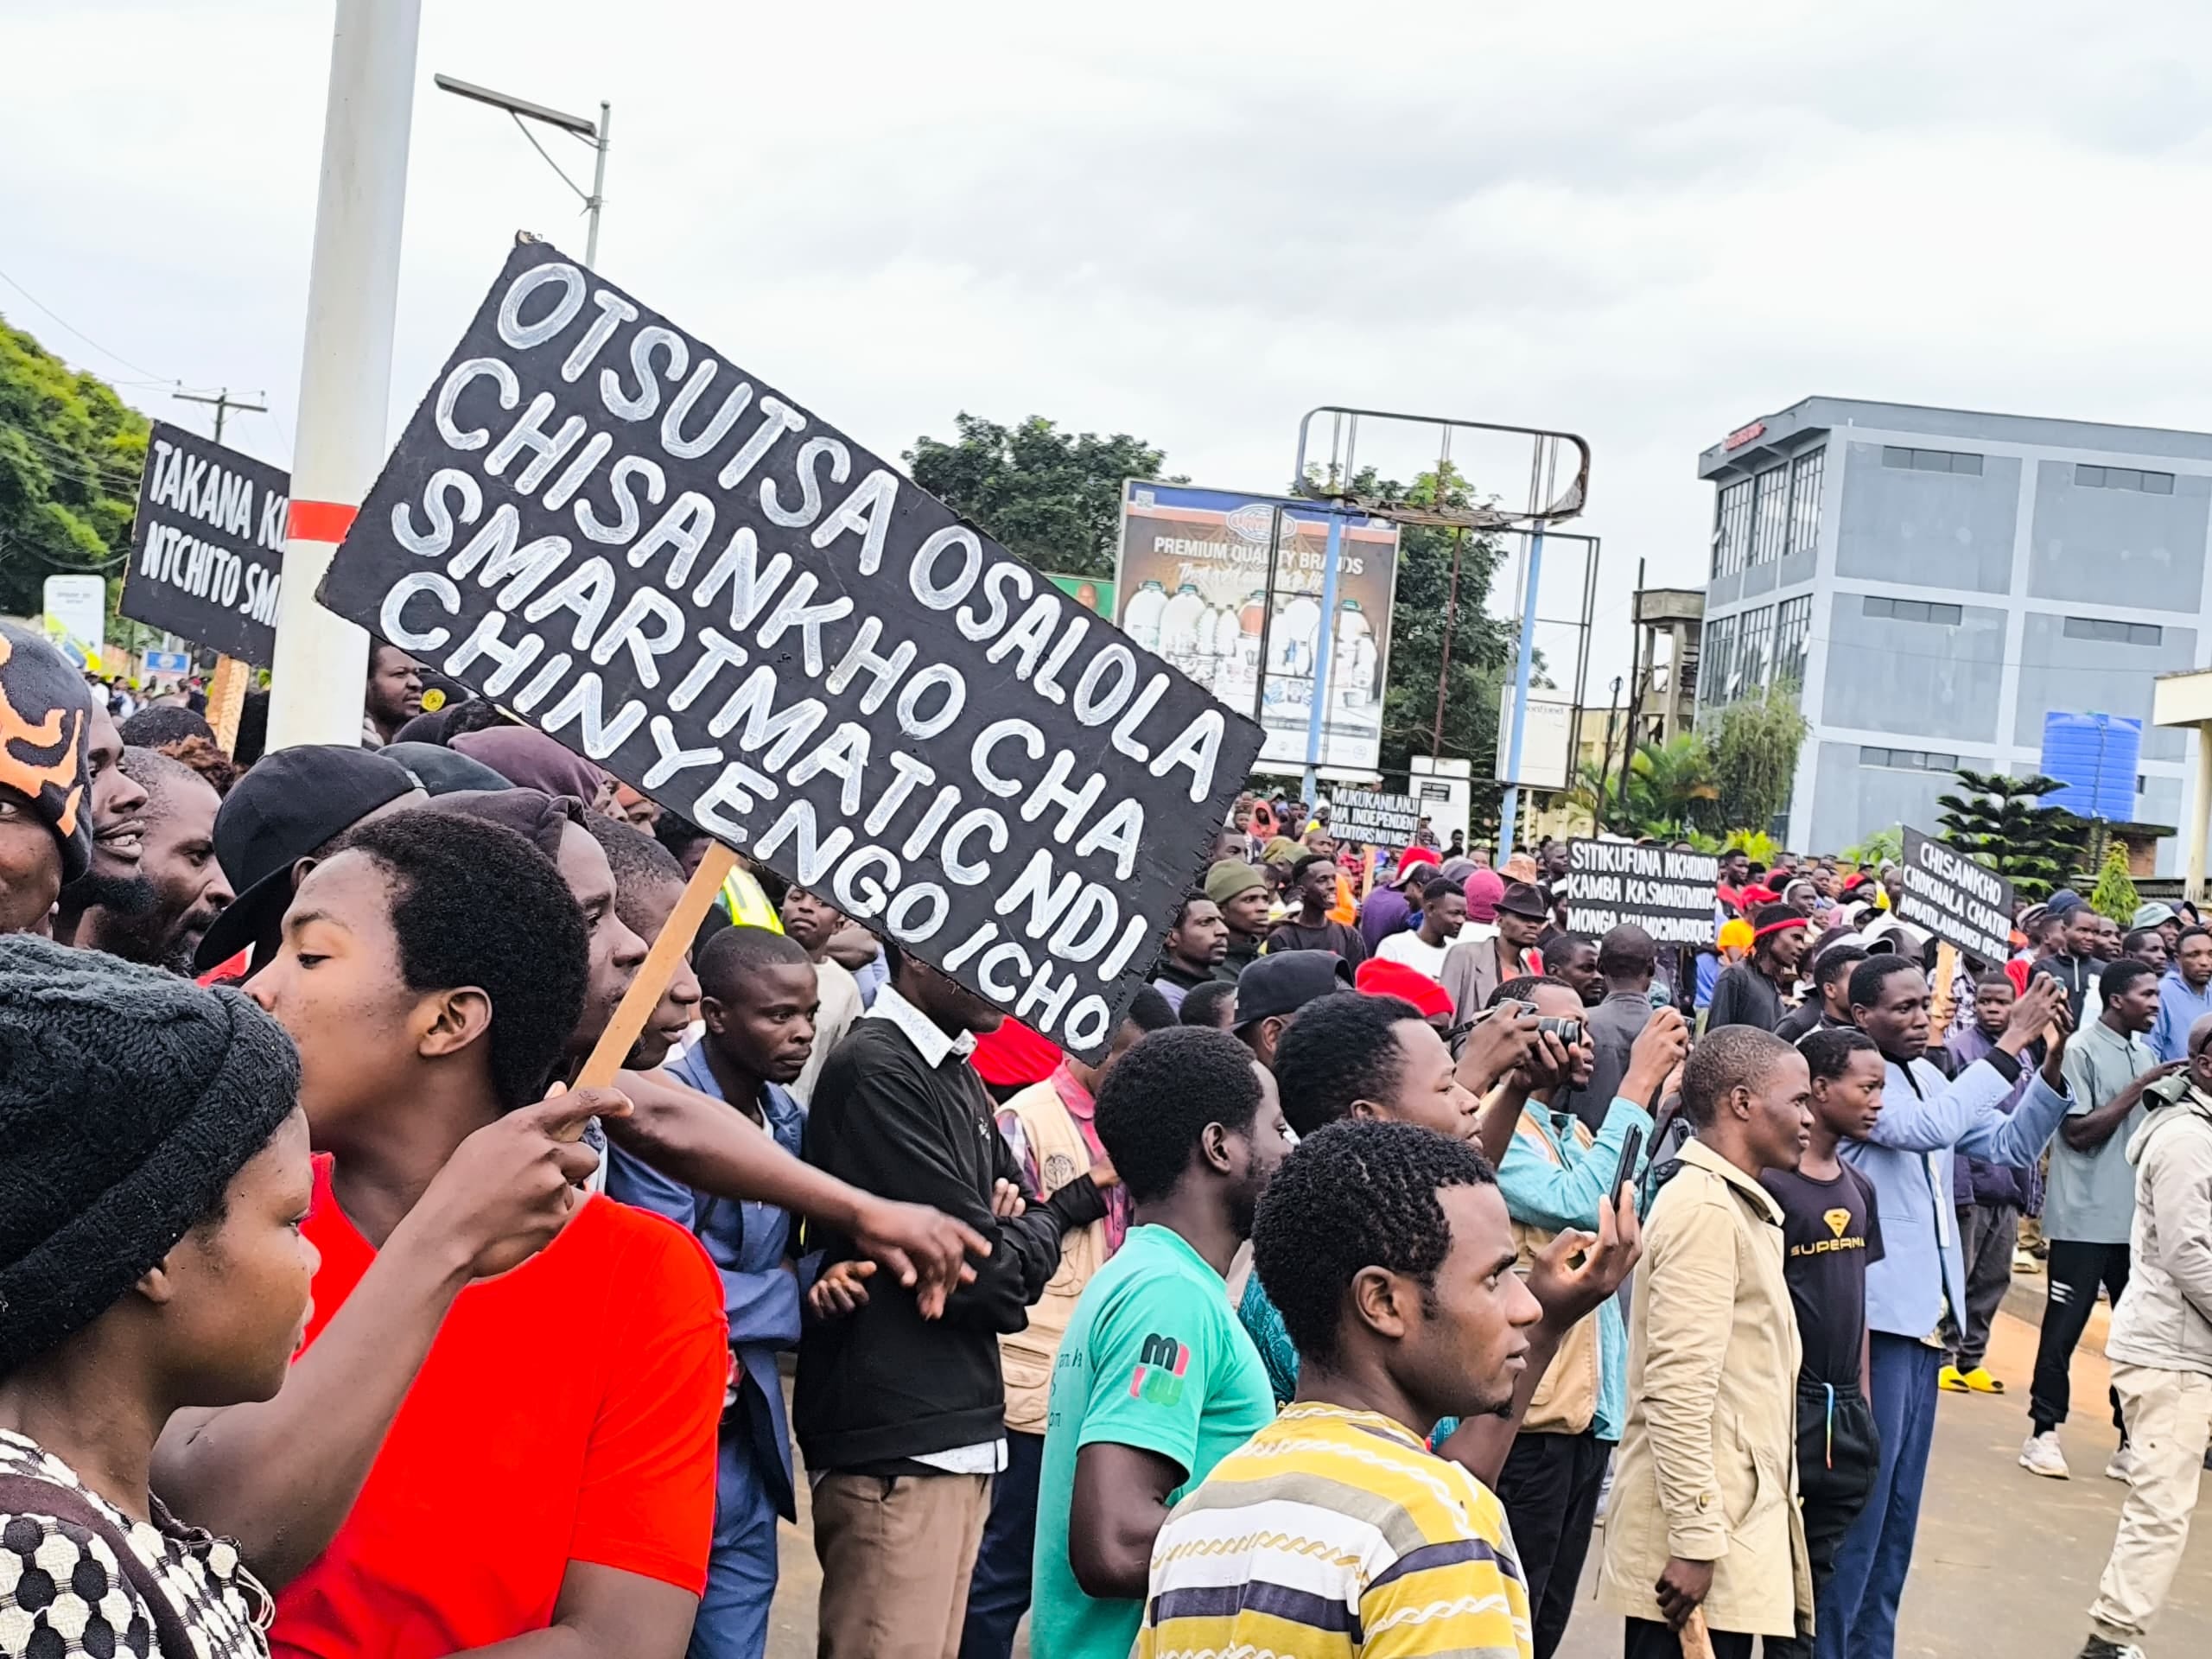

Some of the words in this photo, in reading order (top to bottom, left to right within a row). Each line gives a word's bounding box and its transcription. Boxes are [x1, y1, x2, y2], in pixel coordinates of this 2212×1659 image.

[149, 439, 254, 540] TAKANA
[140, 520, 242, 607] NTCHITO
[497, 263, 898, 575] OTSUTSA
[909, 525, 1224, 803] OSALOLA
[1154, 536, 1227, 560] PREMIUM
[1230, 544, 1297, 569] QUALTY
[435, 357, 966, 740] CHISANKHO
[971, 718, 1144, 880] CHA
[391, 468, 1008, 886] SMARTMATIC
[995, 848, 1147, 981] NDI
[380, 571, 949, 943] CHINYENGO
[943, 921, 1109, 1049] ICHO
[1327, 822, 1375, 843] AUDITORS
[1331, 804, 1348, 823] MA
[1351, 807, 1419, 831] INDEPENDENT
[1567, 873, 1622, 903] KAMBA
[1570, 841, 1662, 878] SITIKUFUNA
[1664, 851, 1719, 882] NKHONDO
[1920, 842, 2002, 906] CHISANKHO
[1566, 907, 1618, 935] MONGA
[1903, 864, 1965, 918] CHOKHALA
[1967, 900, 2012, 942] CHATHU
